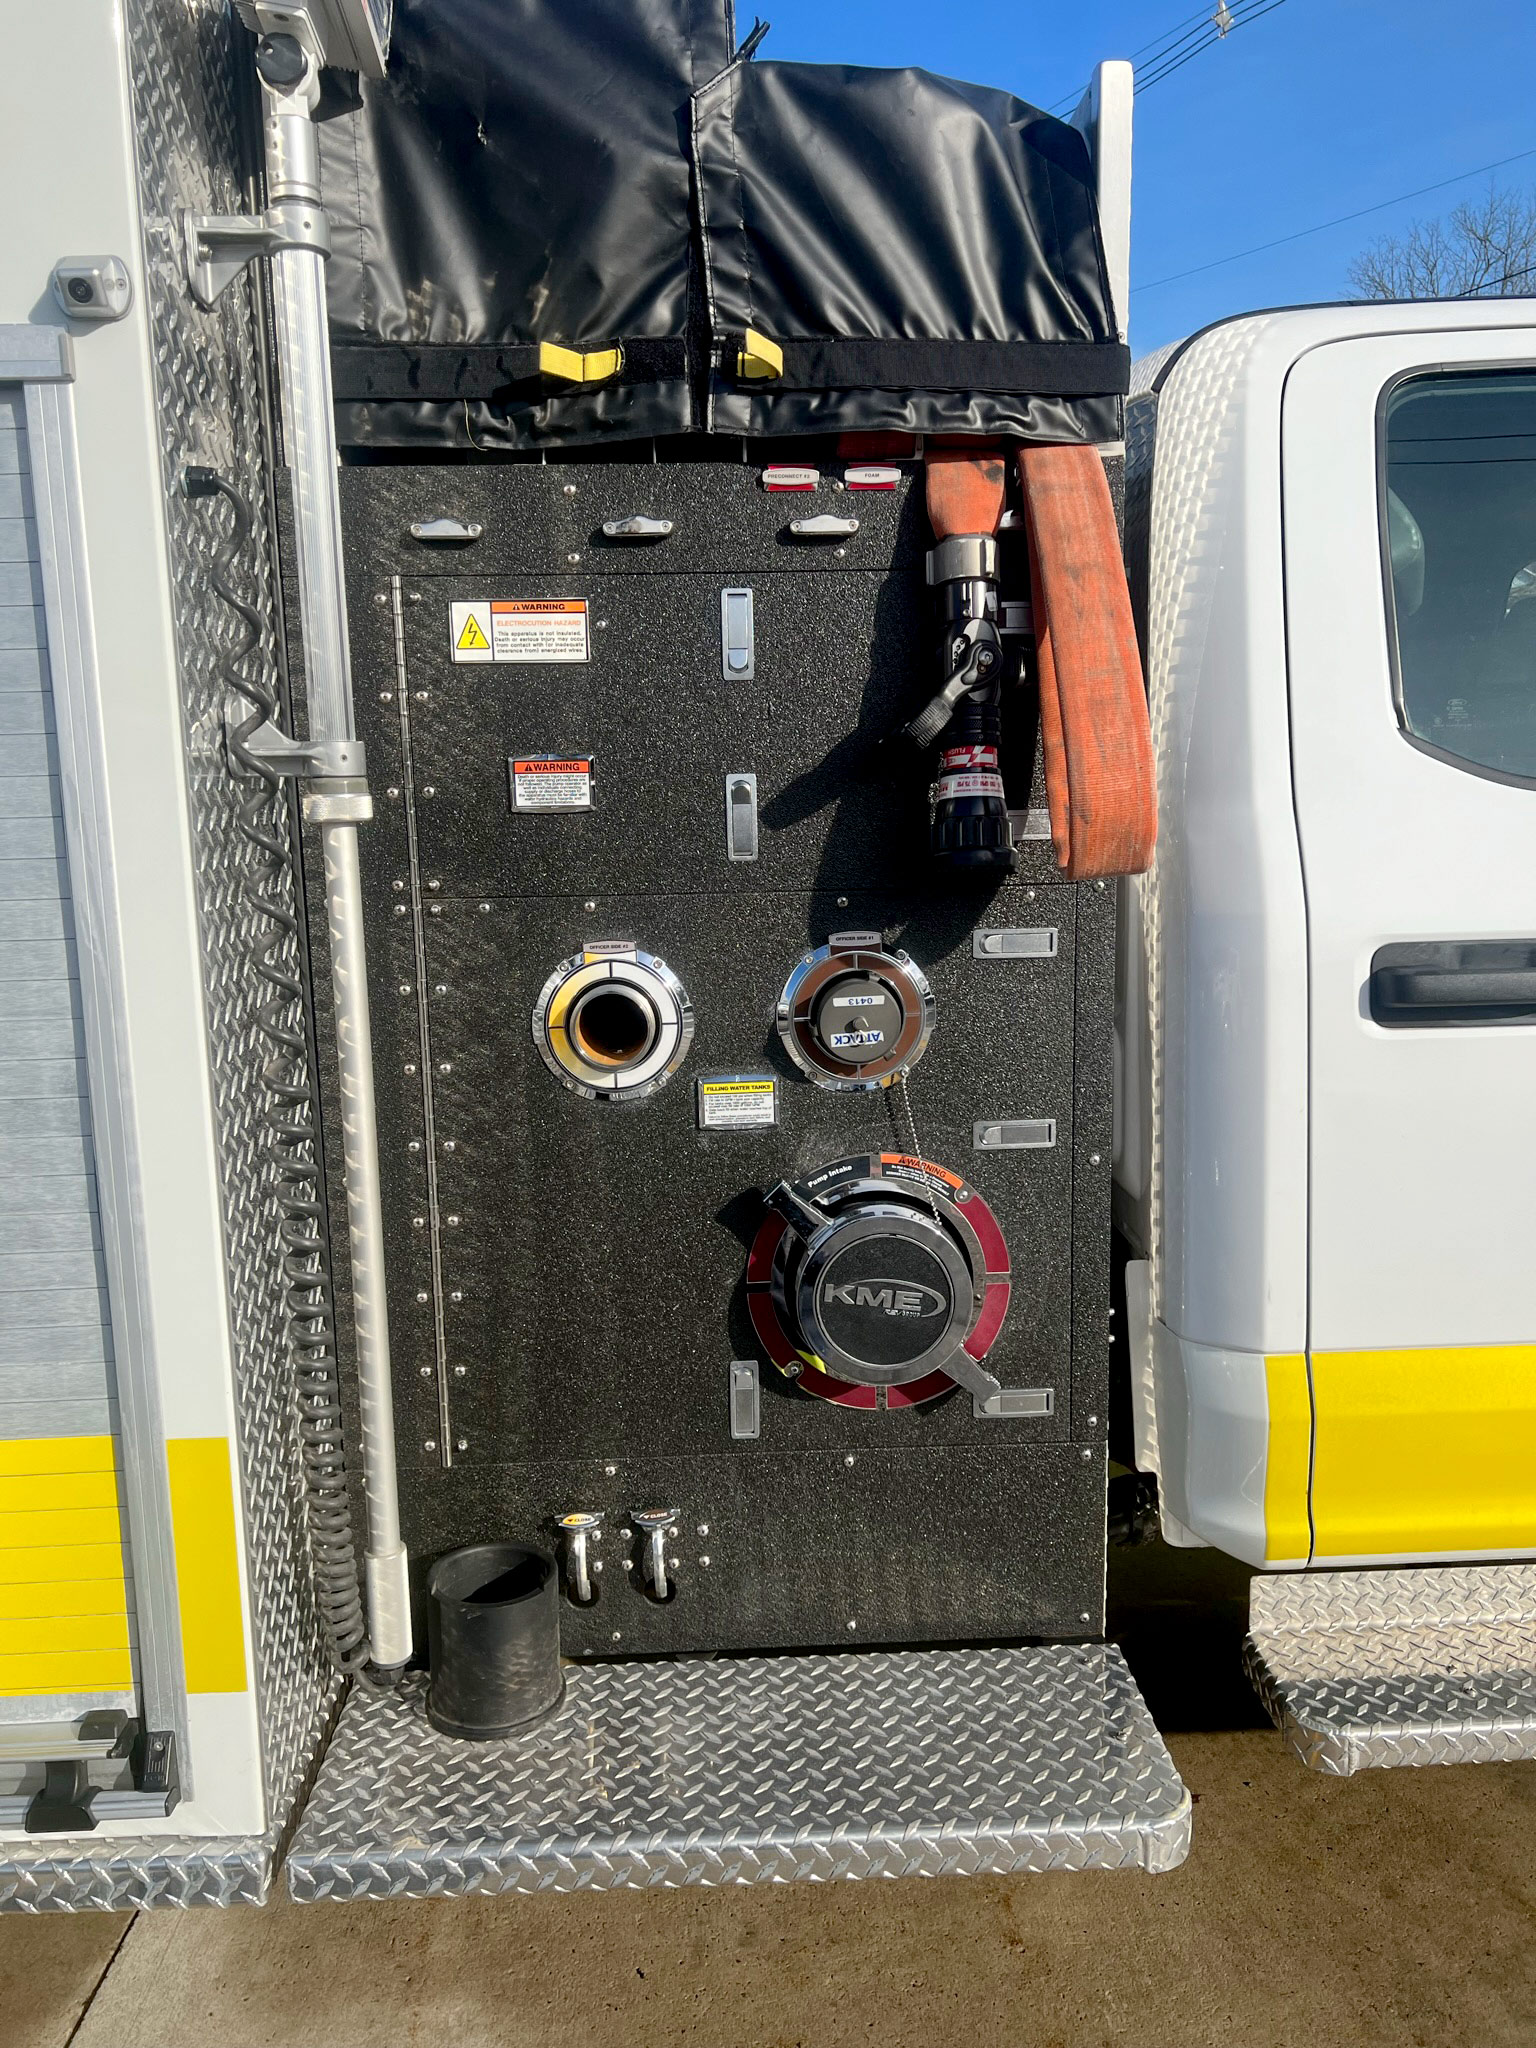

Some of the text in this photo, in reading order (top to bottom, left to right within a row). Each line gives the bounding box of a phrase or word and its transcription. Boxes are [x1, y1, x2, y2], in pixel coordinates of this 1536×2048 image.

[521, 603, 566, 611] WARNING
[532, 763, 580, 771] WARNING
[807, 1165, 852, 1188] Pump Intake
[906, 1156, 946, 1178] WARNING
[824, 1284, 923, 1311] KME
